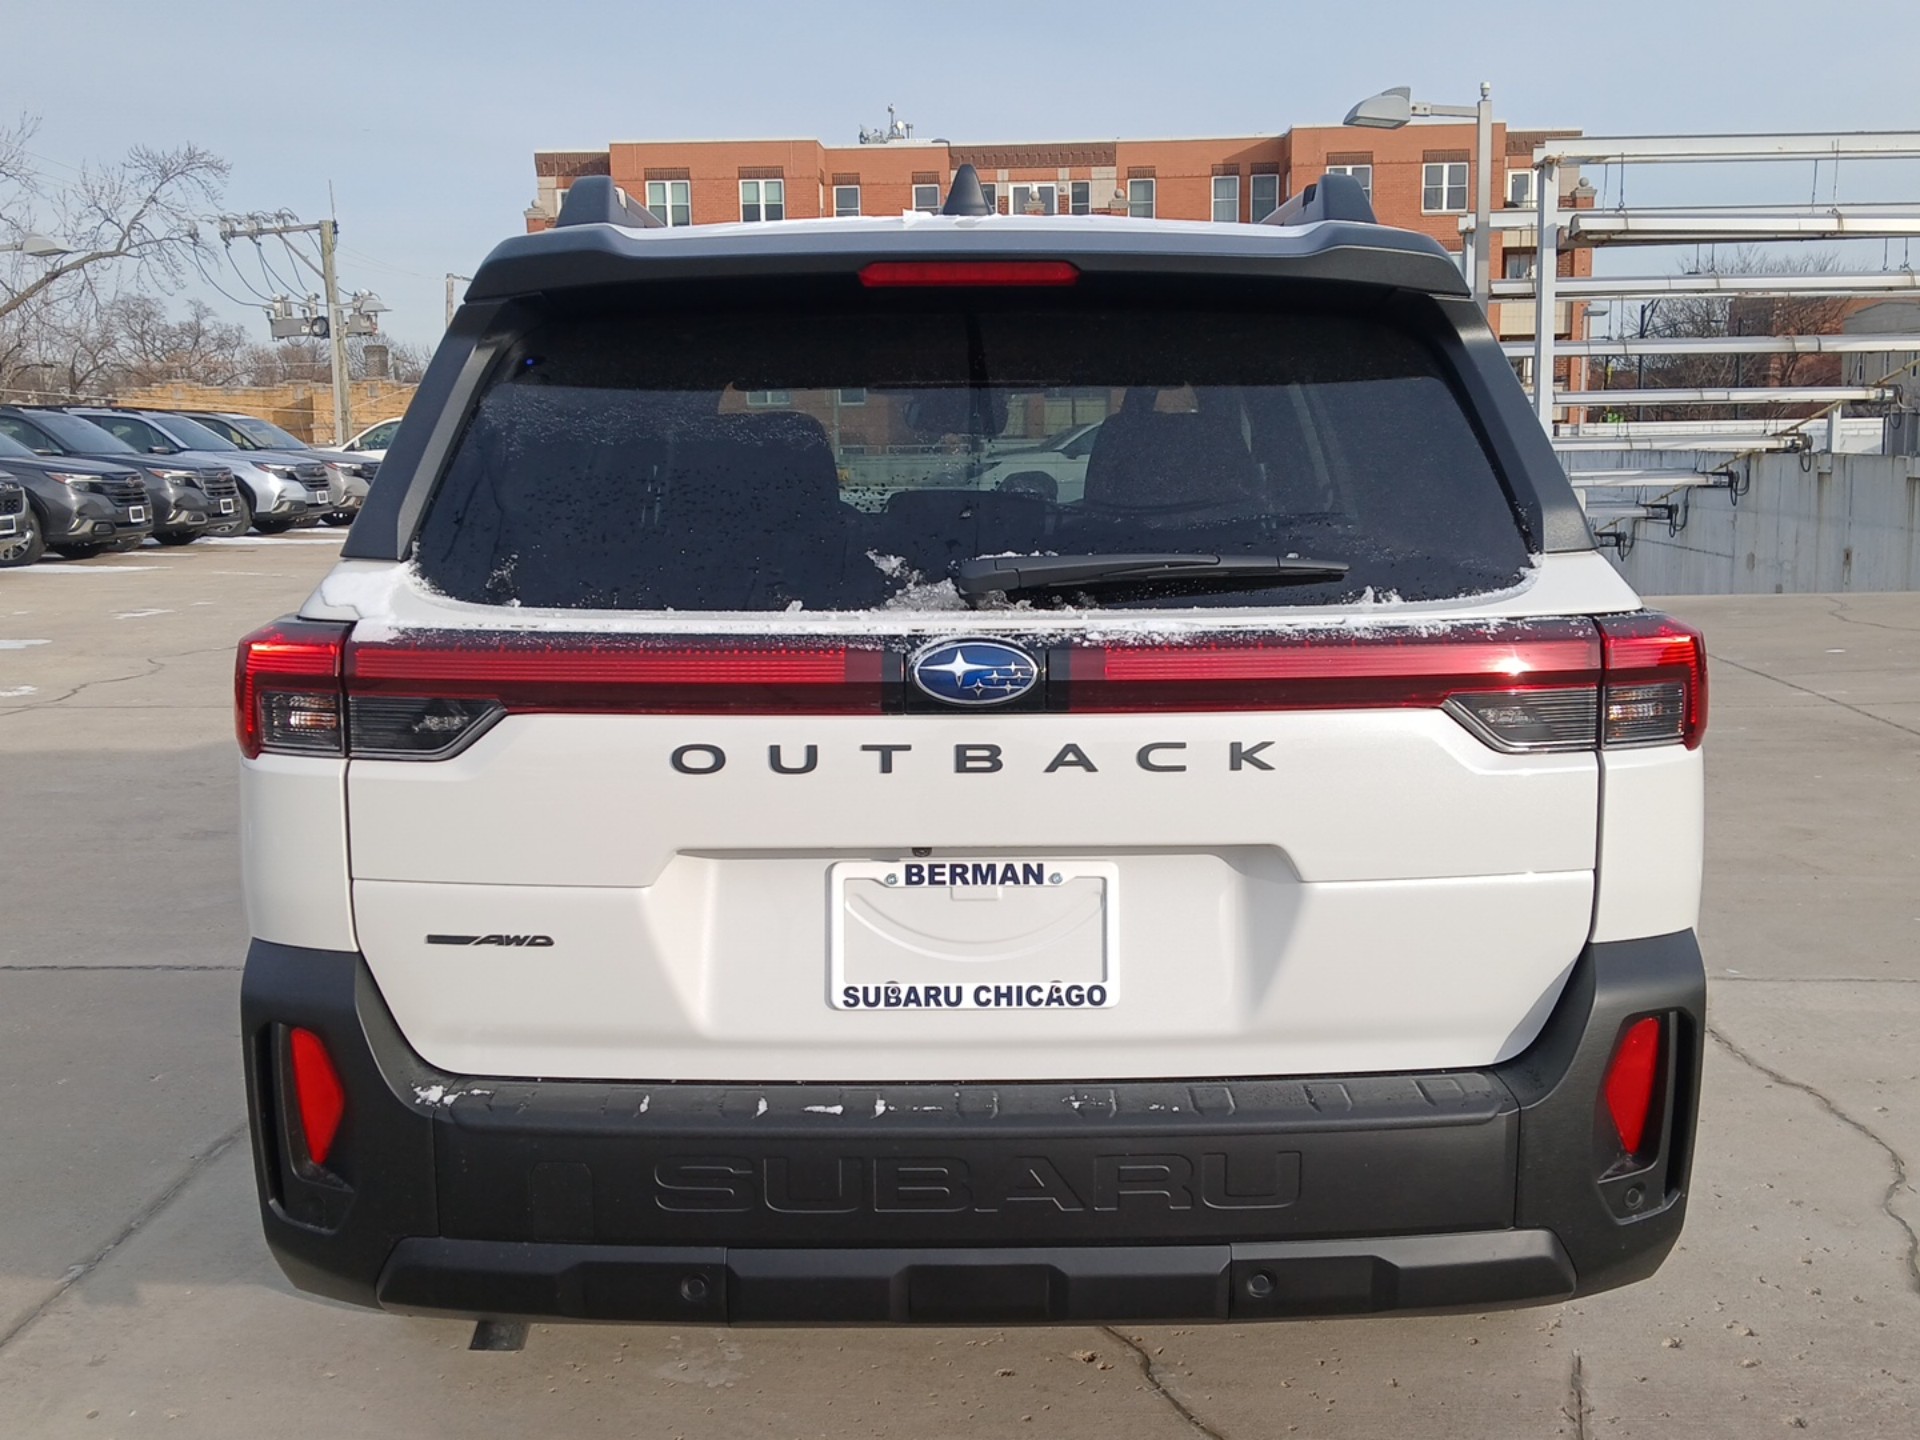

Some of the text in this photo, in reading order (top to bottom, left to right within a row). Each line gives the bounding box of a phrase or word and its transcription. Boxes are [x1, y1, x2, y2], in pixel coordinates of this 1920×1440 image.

[670, 741, 1276, 775] OUTBACK
[904, 863, 1044, 887] BERMAN
[473, 934, 555, 947] AWD
[843, 984, 1108, 1008] SUBARU CHICAGO
[653, 1150, 1302, 1214] SUBARU
